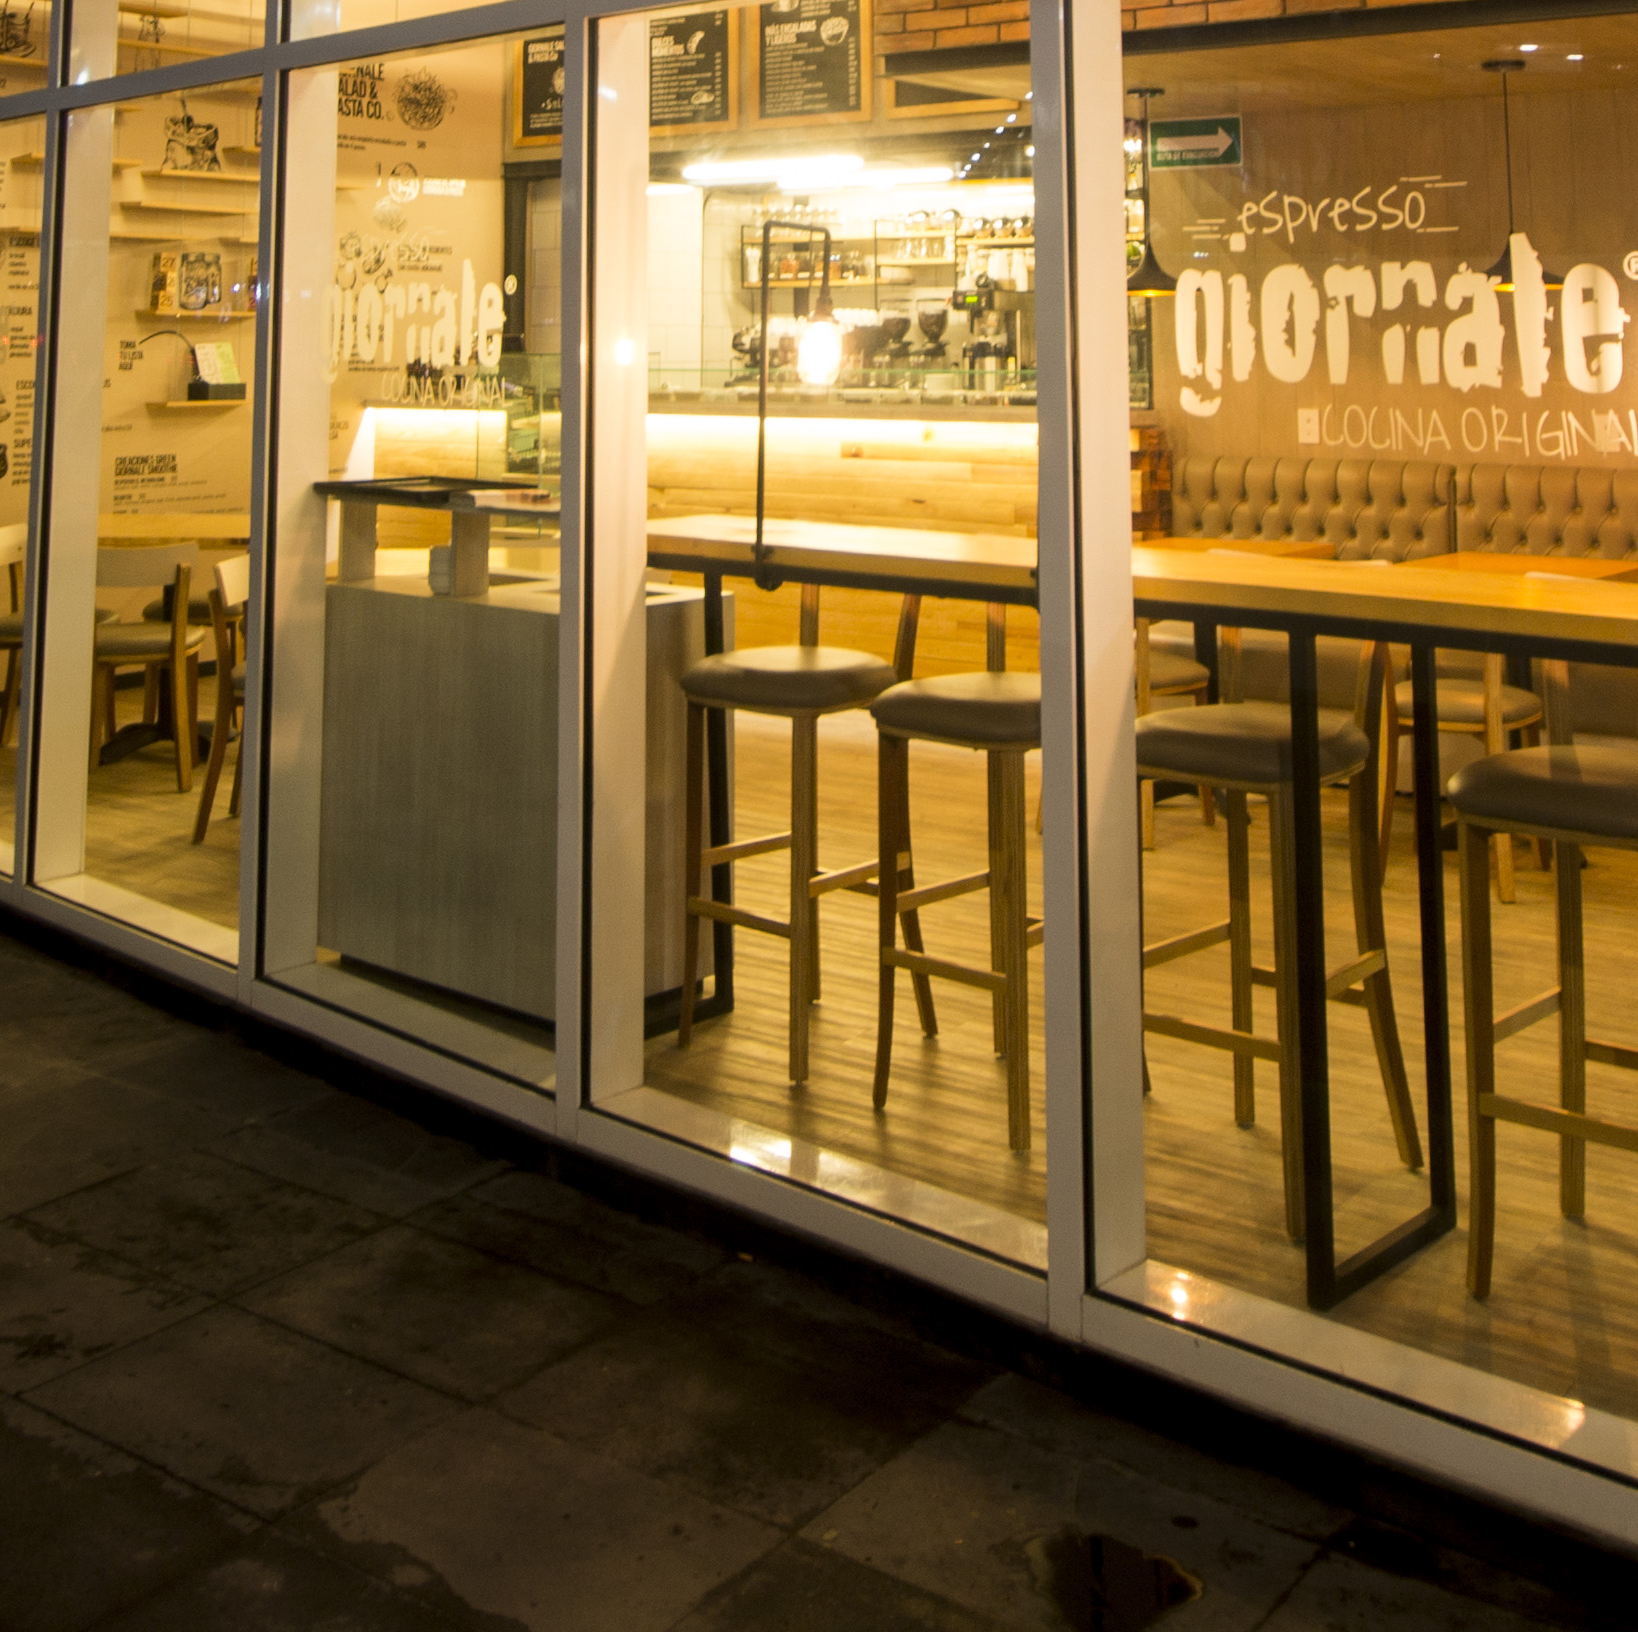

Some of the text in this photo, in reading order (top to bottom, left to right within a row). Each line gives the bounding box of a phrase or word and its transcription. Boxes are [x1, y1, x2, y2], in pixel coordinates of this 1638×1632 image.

[1237, 185, 1427, 244] espresso
[1175, 232, 1630, 417] giornale
[1322, 406, 1452, 455] COCINA
